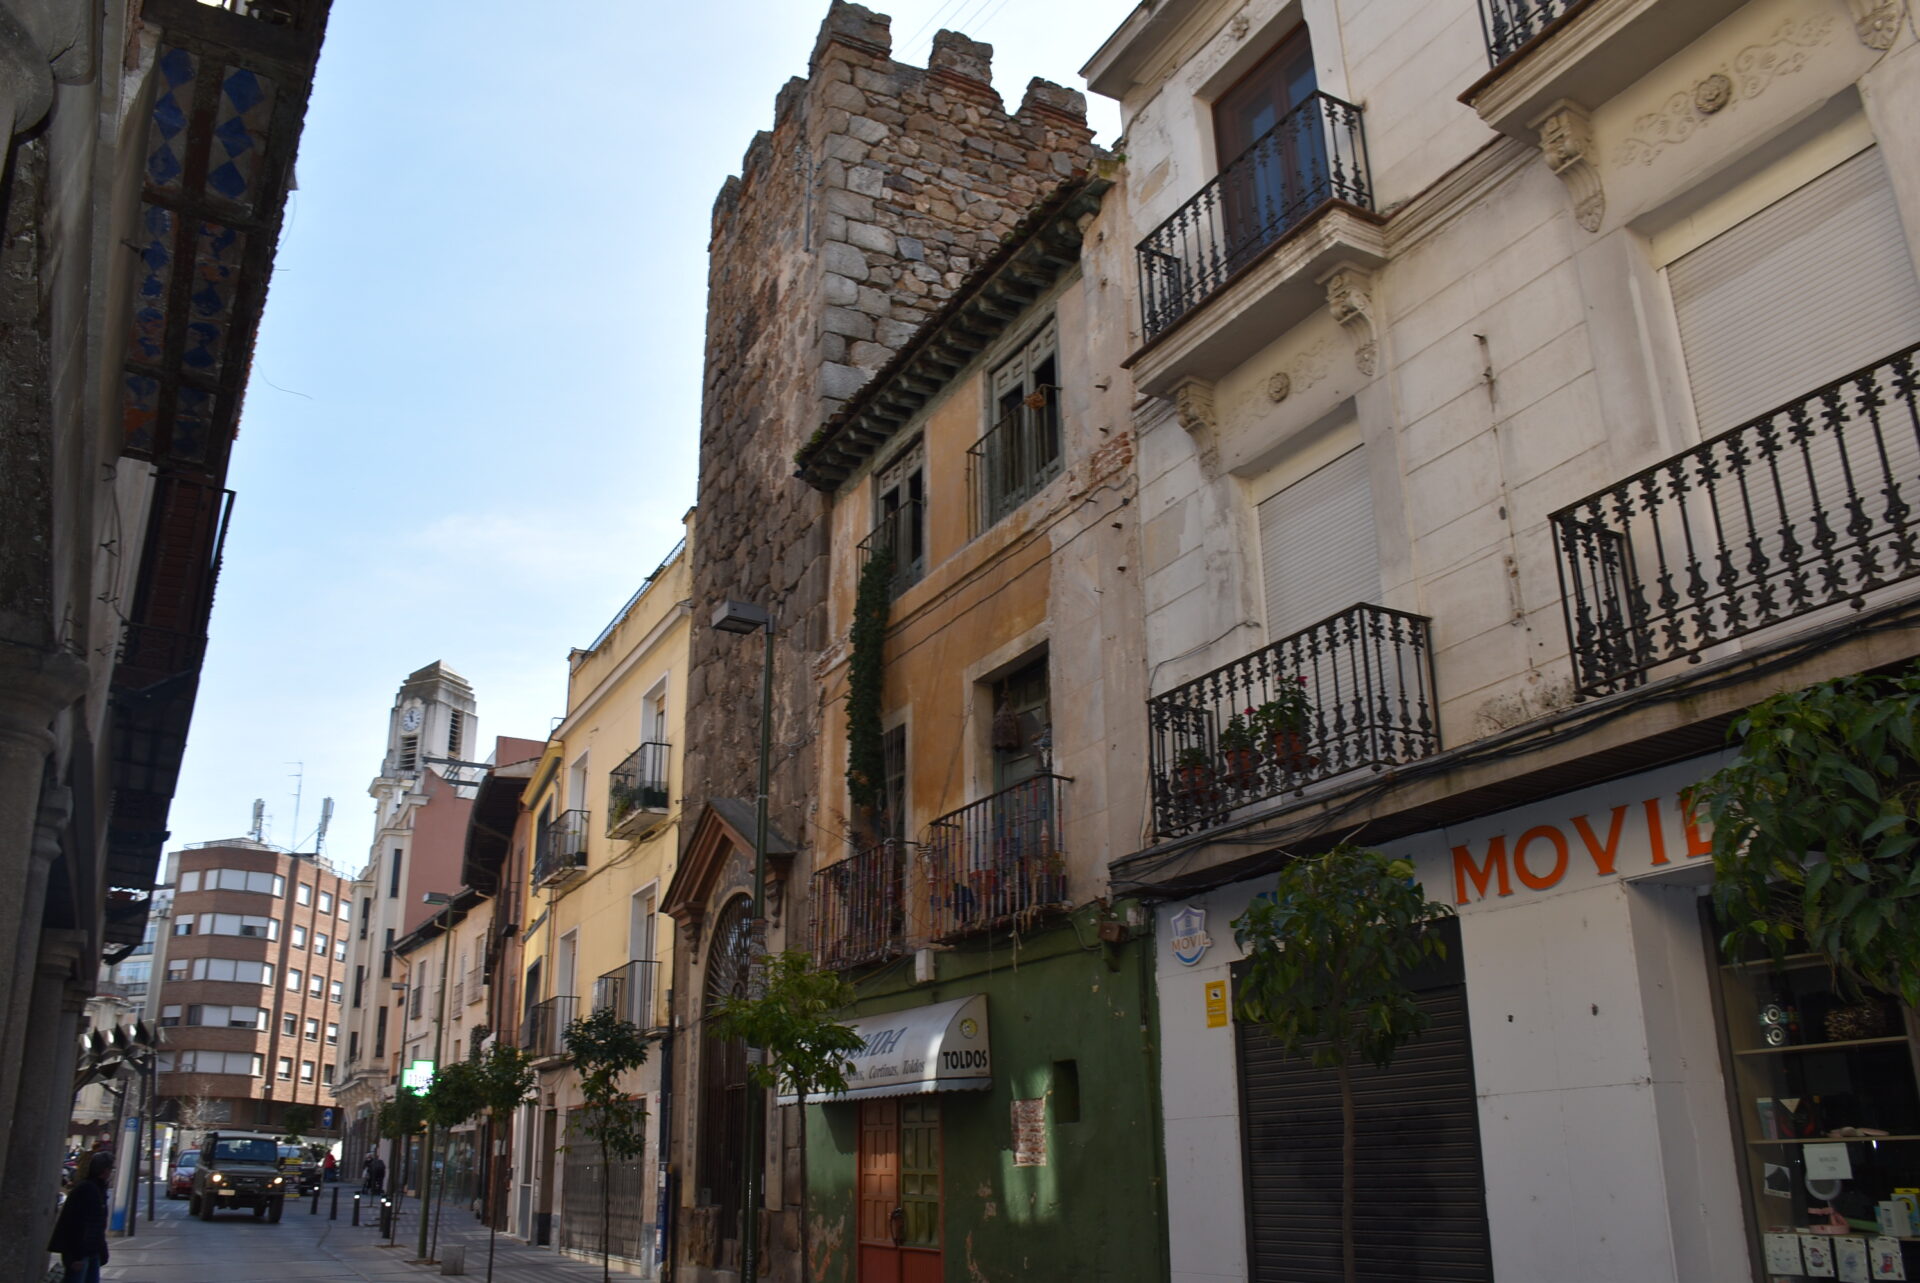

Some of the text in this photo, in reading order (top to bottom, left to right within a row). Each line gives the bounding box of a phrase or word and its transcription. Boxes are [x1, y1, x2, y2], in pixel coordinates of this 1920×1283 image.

[1172, 932, 1211, 951] MOVIL
[903, 1059, 924, 1074] Toldos
[943, 1050, 988, 1070] TOLDOS
